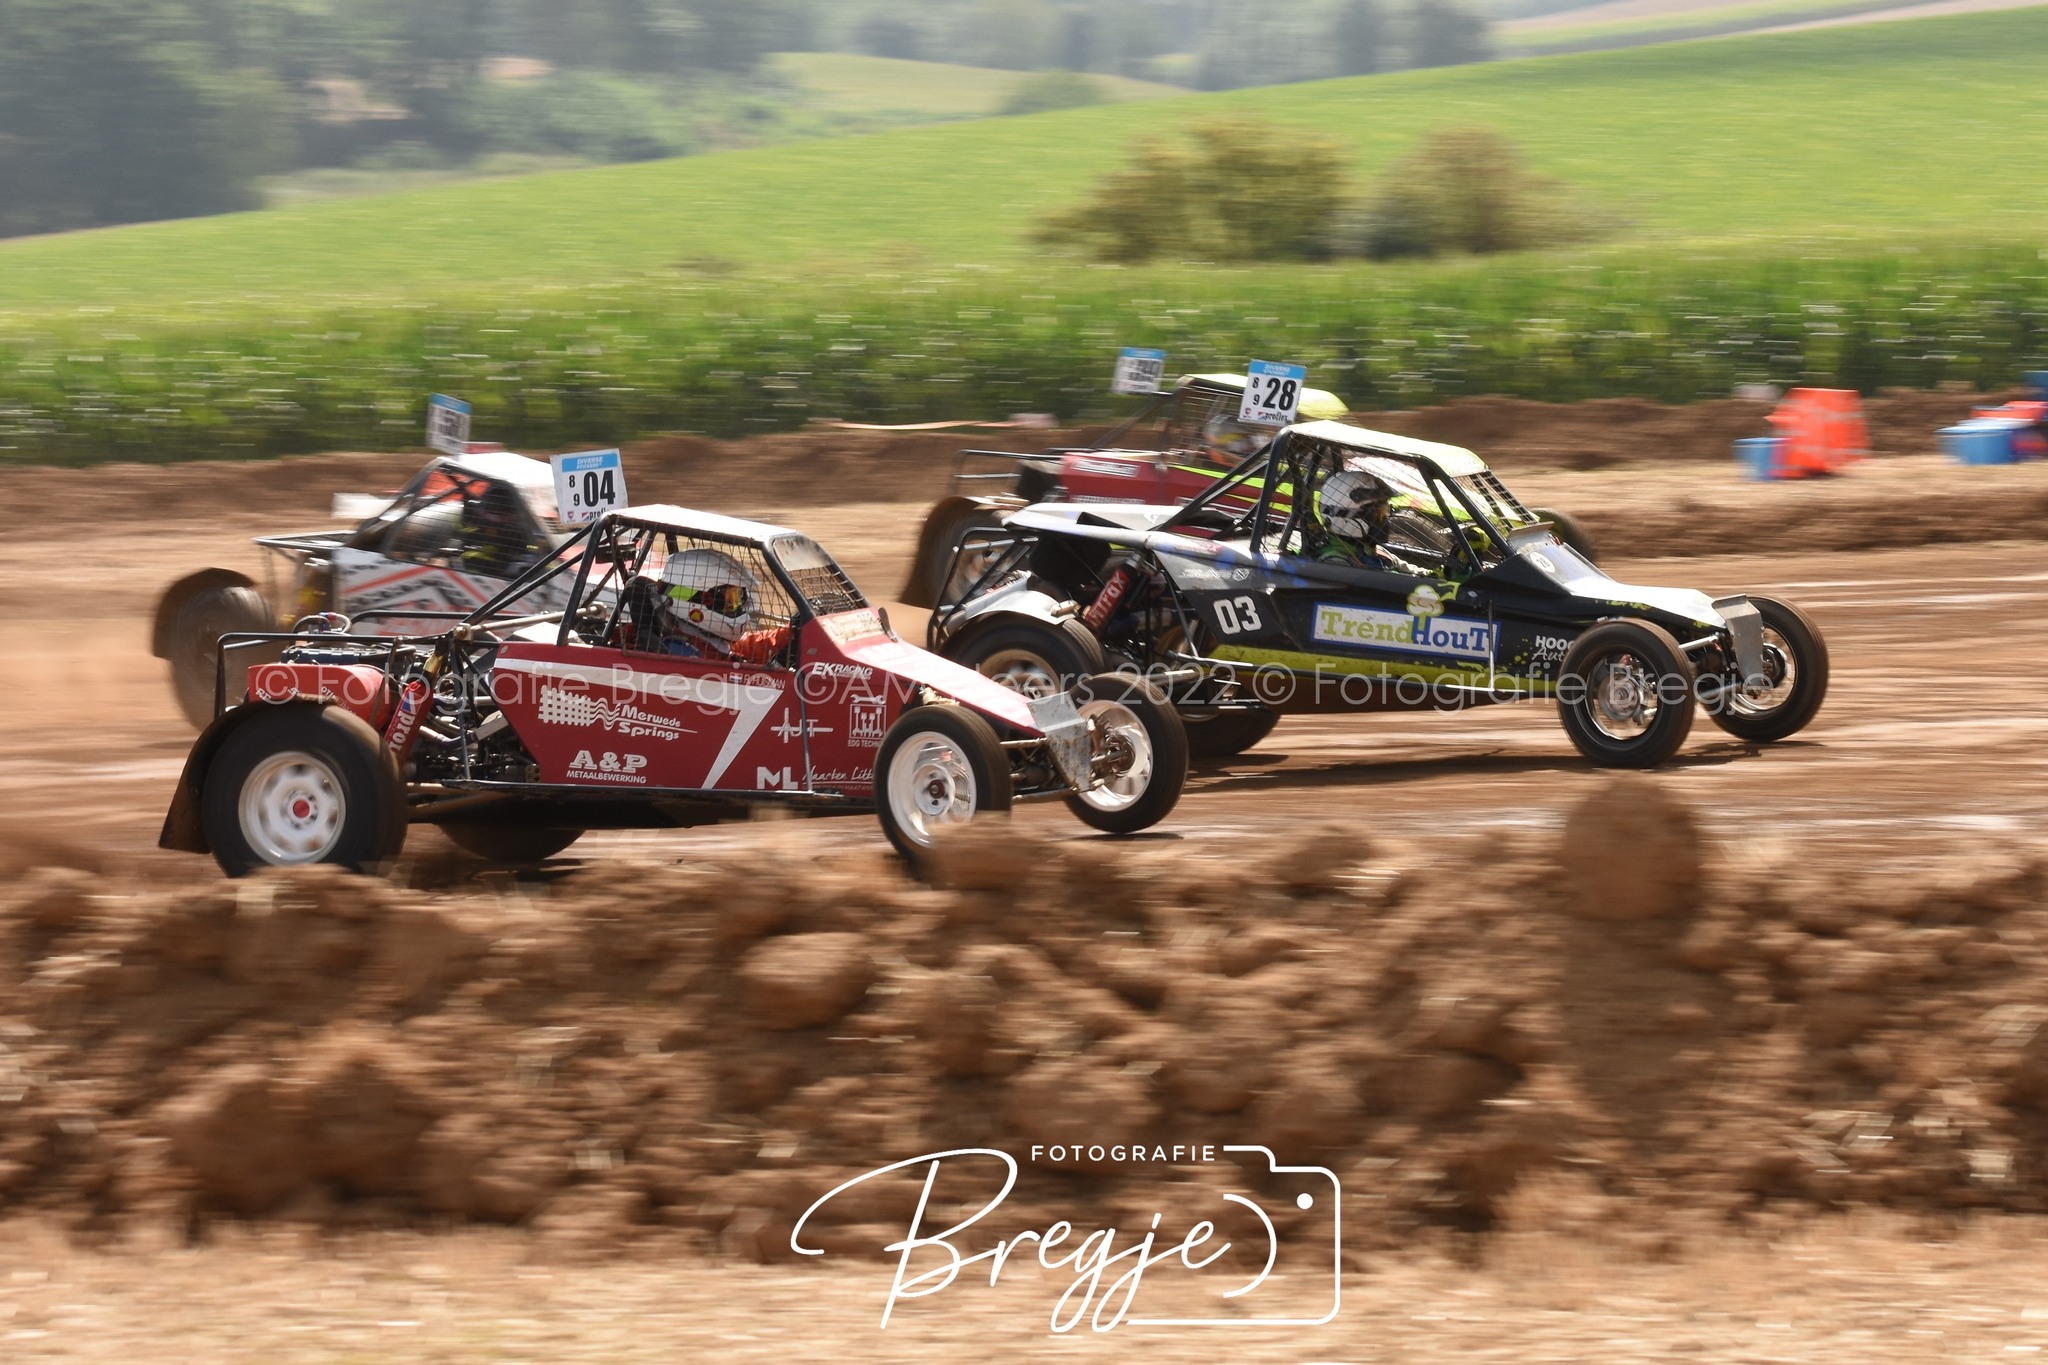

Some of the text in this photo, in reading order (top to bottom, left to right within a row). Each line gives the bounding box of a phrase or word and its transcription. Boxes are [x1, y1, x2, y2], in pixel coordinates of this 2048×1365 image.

[1252, 377, 1260, 389] 8
[1252, 394, 1260, 406] 9
[1263, 377, 1297, 411] 28
[577, 456, 603, 465] DIVERSE
[569, 475, 576, 488] 8
[583, 470, 616, 507] 04
[573, 493, 580, 506] 9
[1213, 596, 1262, 635] 03
[621, 704, 681, 728] Merwede
[618, 721, 680, 741] Springs
[569, 750, 648, 774] A&P
[566, 770, 647, 784] METAALBEWERKING
[757, 766, 798, 790] ML
